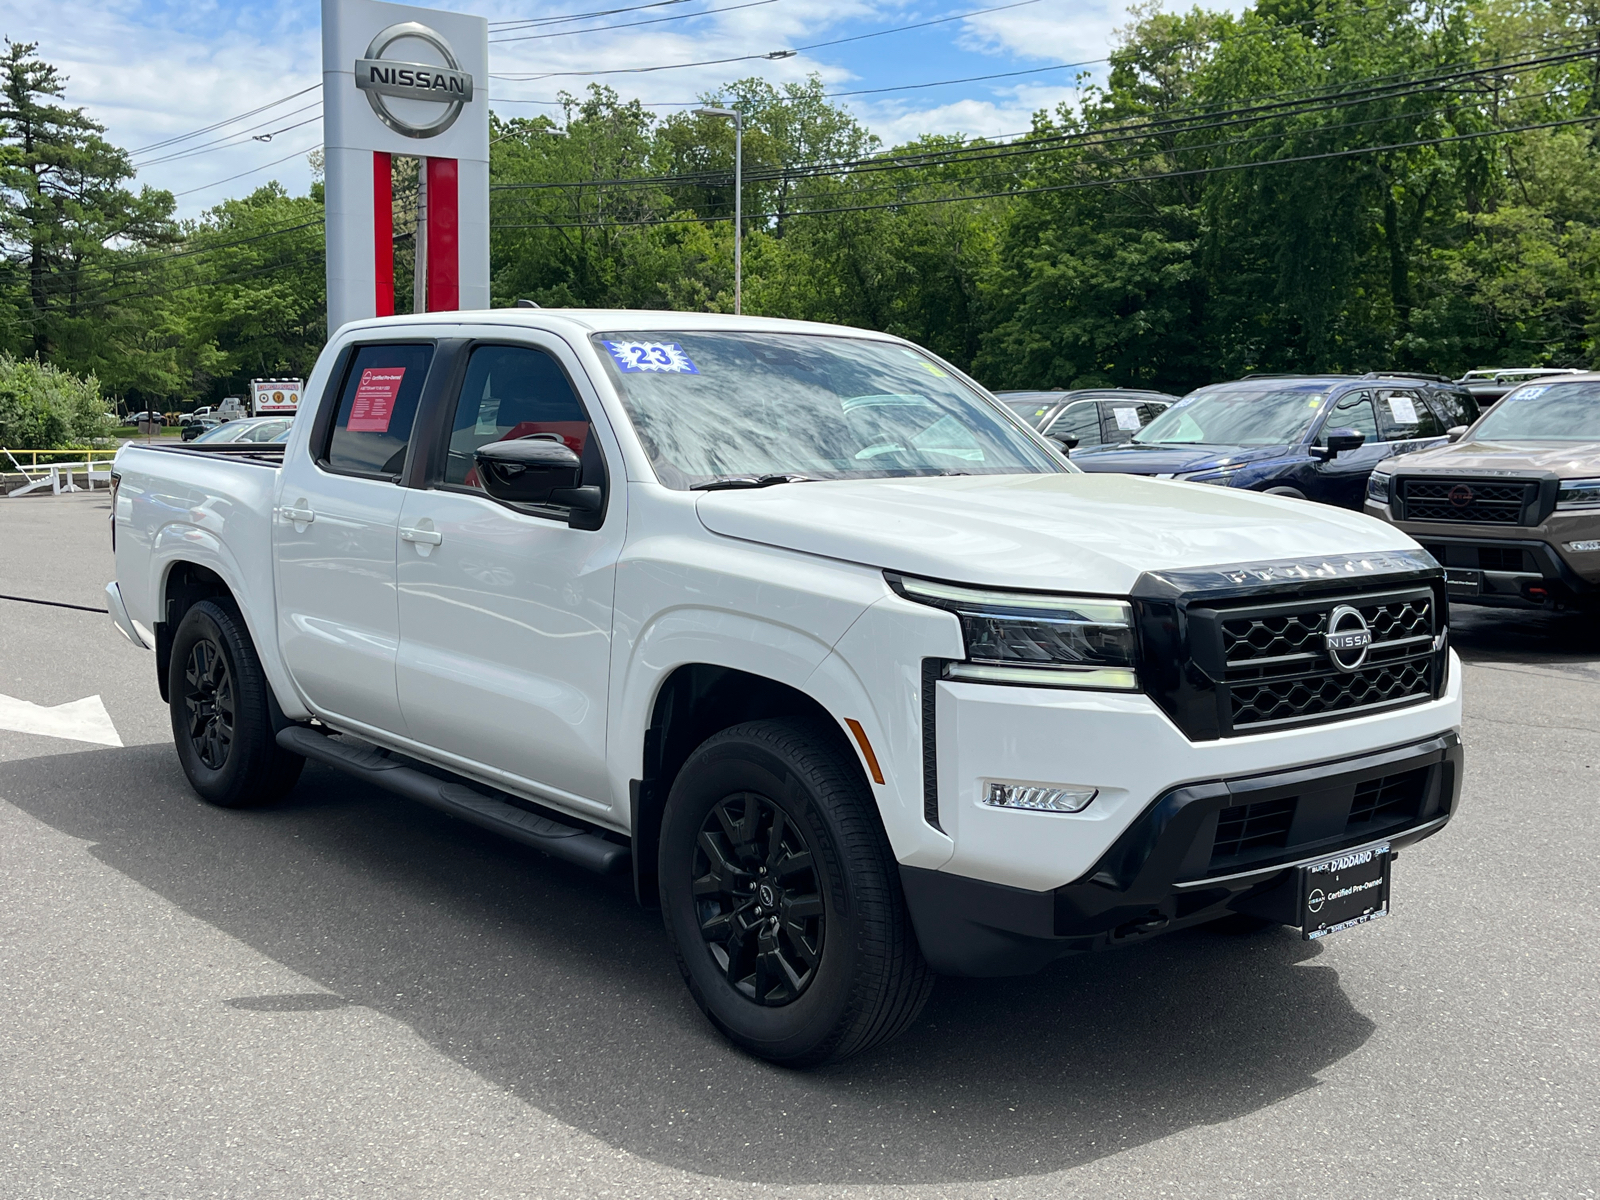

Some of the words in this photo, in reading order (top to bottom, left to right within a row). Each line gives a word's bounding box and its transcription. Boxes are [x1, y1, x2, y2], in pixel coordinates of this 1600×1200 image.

[370, 66, 464, 94] NISSAN
[630, 346, 672, 365] 23
[1328, 633, 1372, 648] NISSAN
[1311, 864, 1329, 873] BUICK
[1330, 851, 1372, 872] D'ADDARIO
[1327, 886, 1353, 901] Certified
[1352, 876, 1383, 893] Pre-Owned
[1308, 896, 1326, 905] NISSAN
[1331, 918, 1358, 933] SHELTON
[1359, 916, 1368, 924] CT
